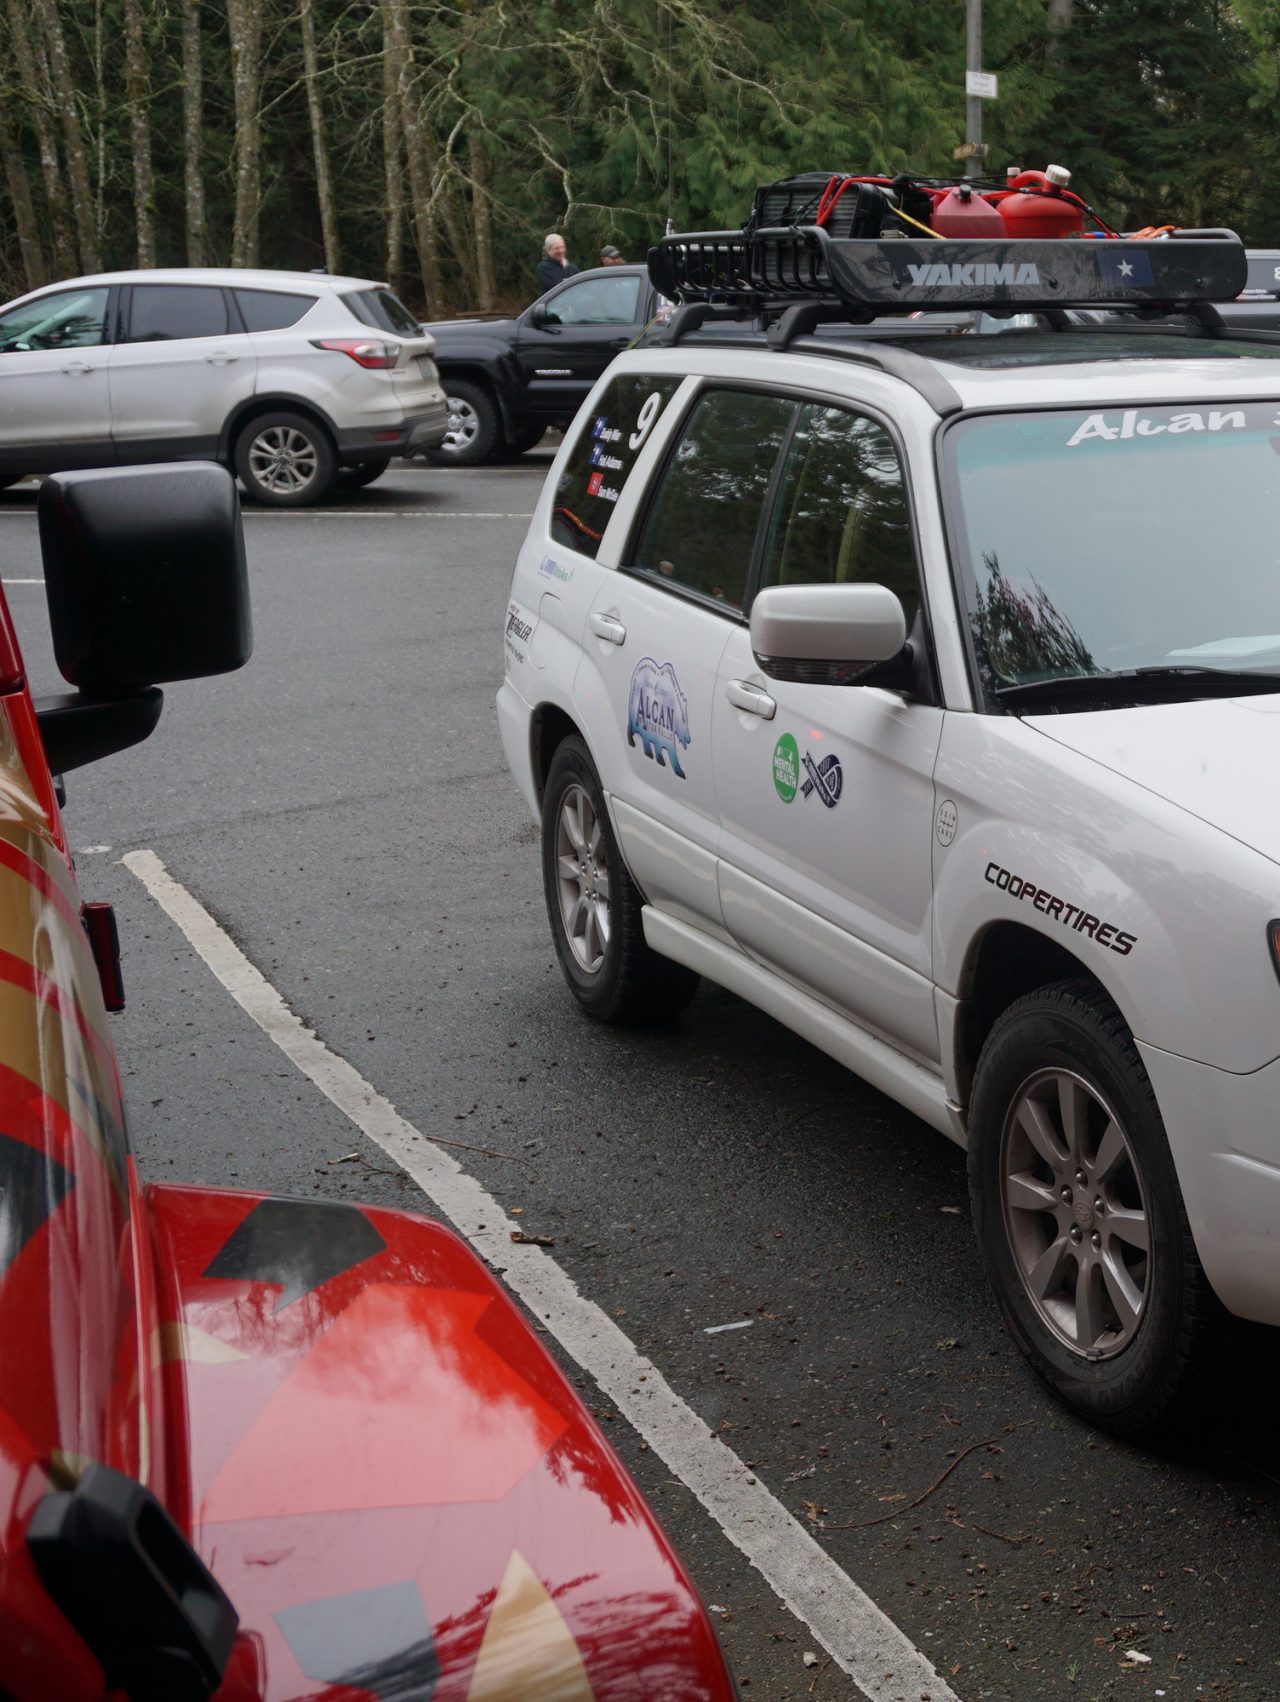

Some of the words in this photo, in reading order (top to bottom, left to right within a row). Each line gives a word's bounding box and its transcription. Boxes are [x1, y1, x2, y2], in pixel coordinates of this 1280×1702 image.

[907, 263, 1039, 286] YAKIMA
[628, 391, 661, 450] 9
[1066, 409, 1246, 446] Alcan
[636, 687, 674, 732] ALCAN
[984, 862, 1138, 956] COOPERTIRES
